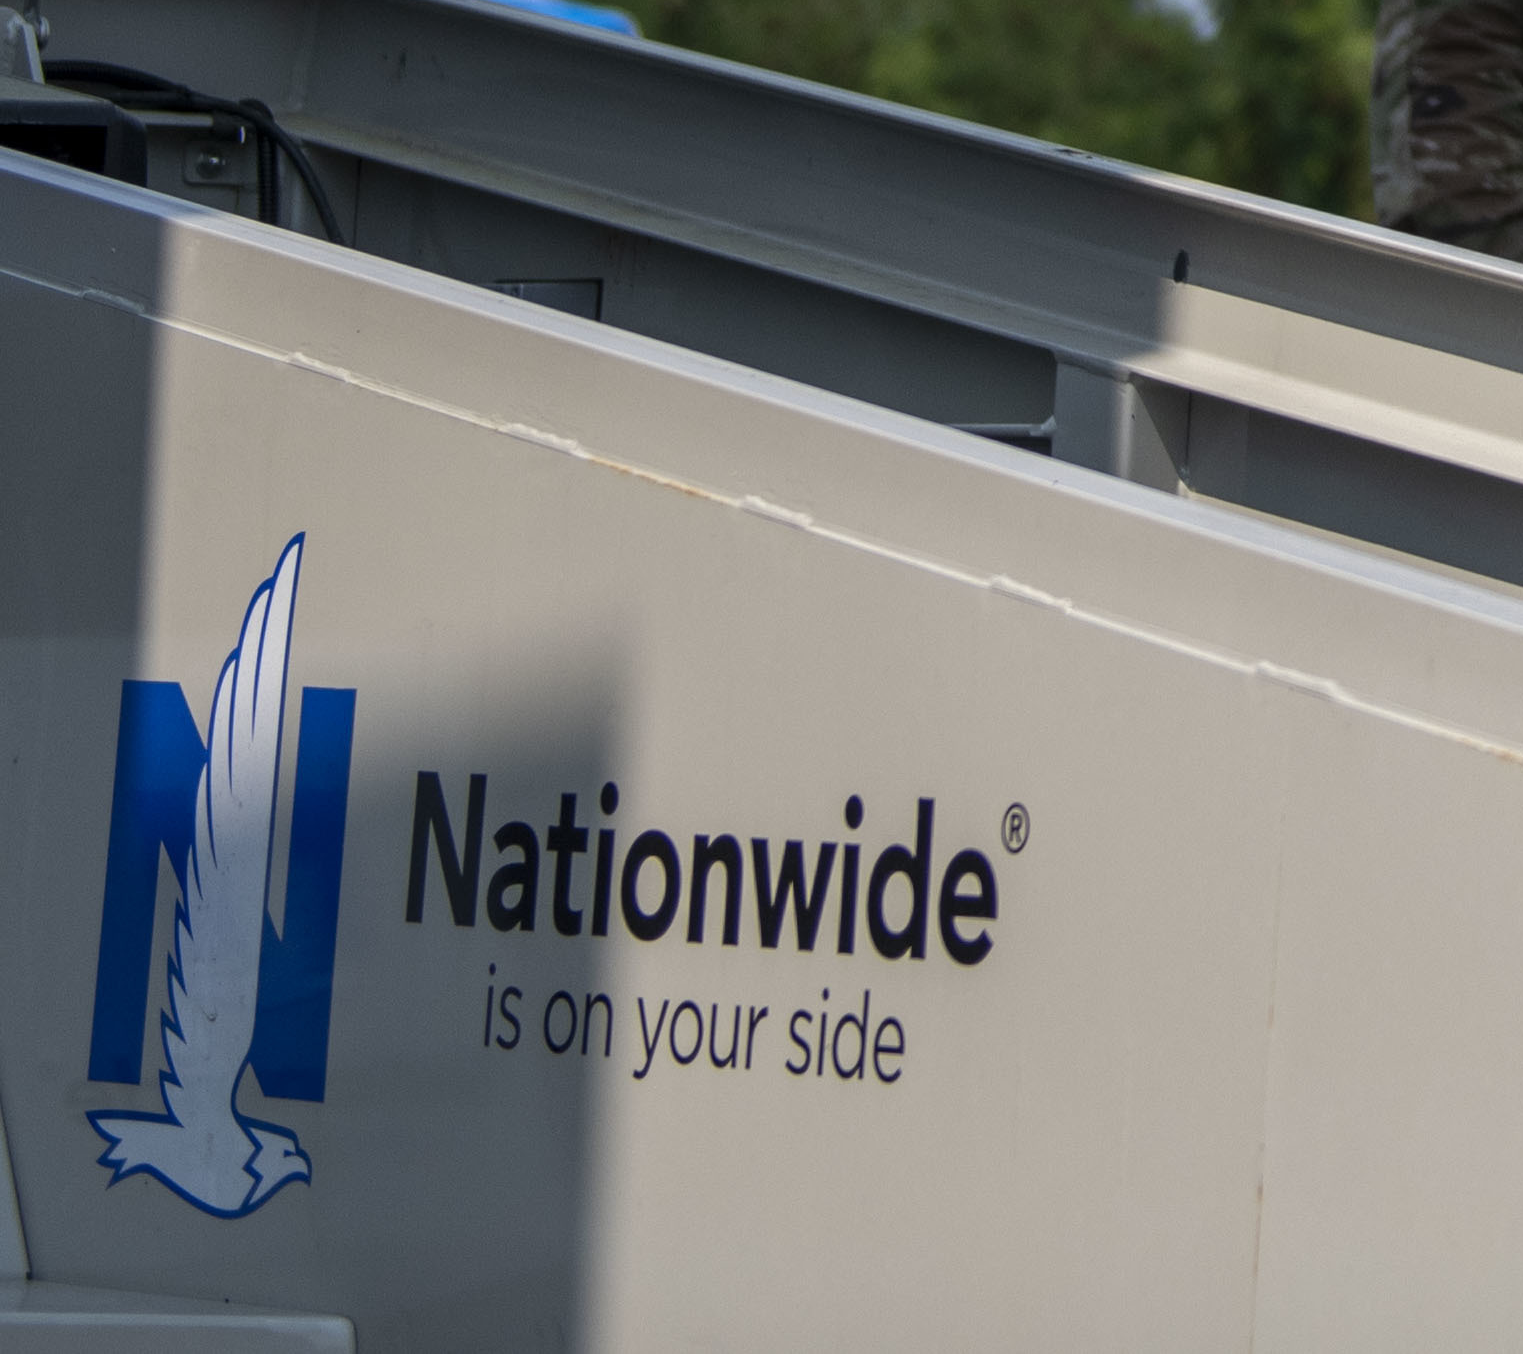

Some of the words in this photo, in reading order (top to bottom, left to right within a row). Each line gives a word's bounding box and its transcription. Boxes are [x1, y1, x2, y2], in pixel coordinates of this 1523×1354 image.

[482, 962, 523, 1050] is
[543, 990, 615, 1058] on
[631, 996, 770, 1081] your
[784, 988, 908, 1085] side
